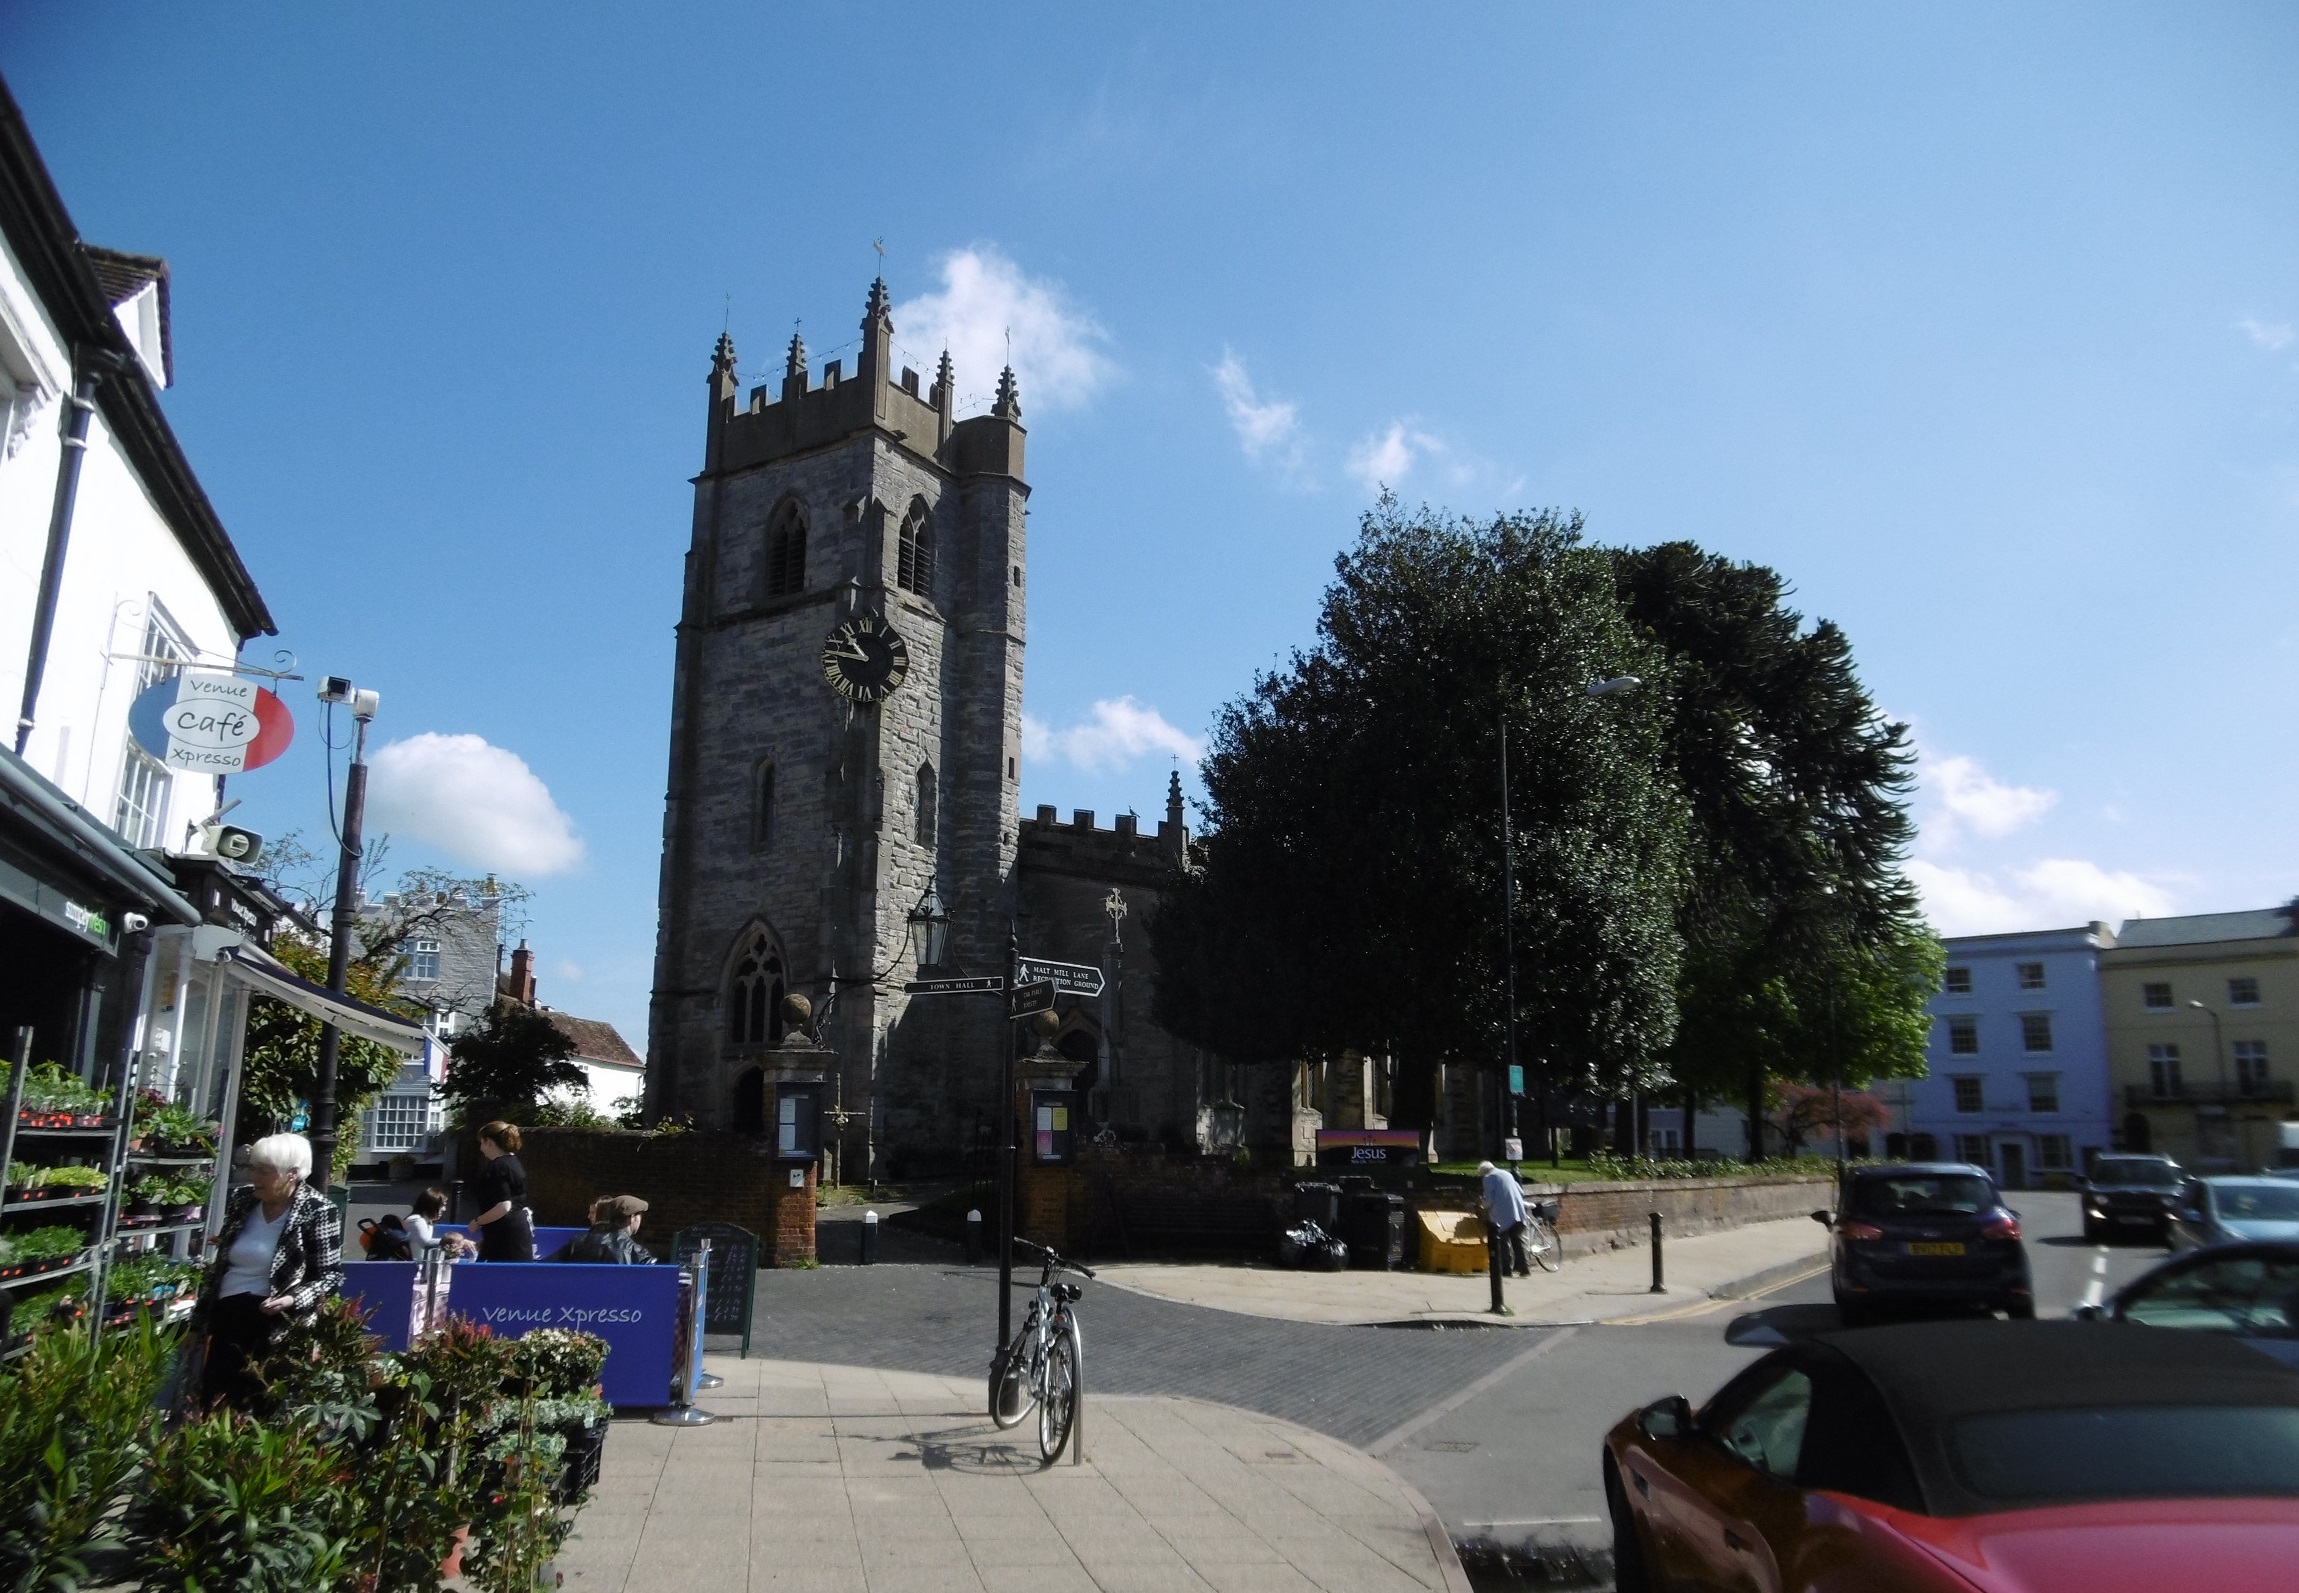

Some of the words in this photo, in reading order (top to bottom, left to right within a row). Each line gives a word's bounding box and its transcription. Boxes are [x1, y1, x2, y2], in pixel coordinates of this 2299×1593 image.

[190, 680, 248, 698] Venue
[177, 711, 248, 742] Café
[170, 747, 241, 767] Xpresso
[1033, 966, 1050, 975] MALT
[1053, 968, 1069, 977] MILL
[1073, 971, 1089, 980] LANE
[1074, 980, 1099, 990] GROUND
[1351, 1146, 1387, 1160] Jesus
[482, 1306, 552, 1323] Venue
[557, 1306, 642, 1332] Xpresso
